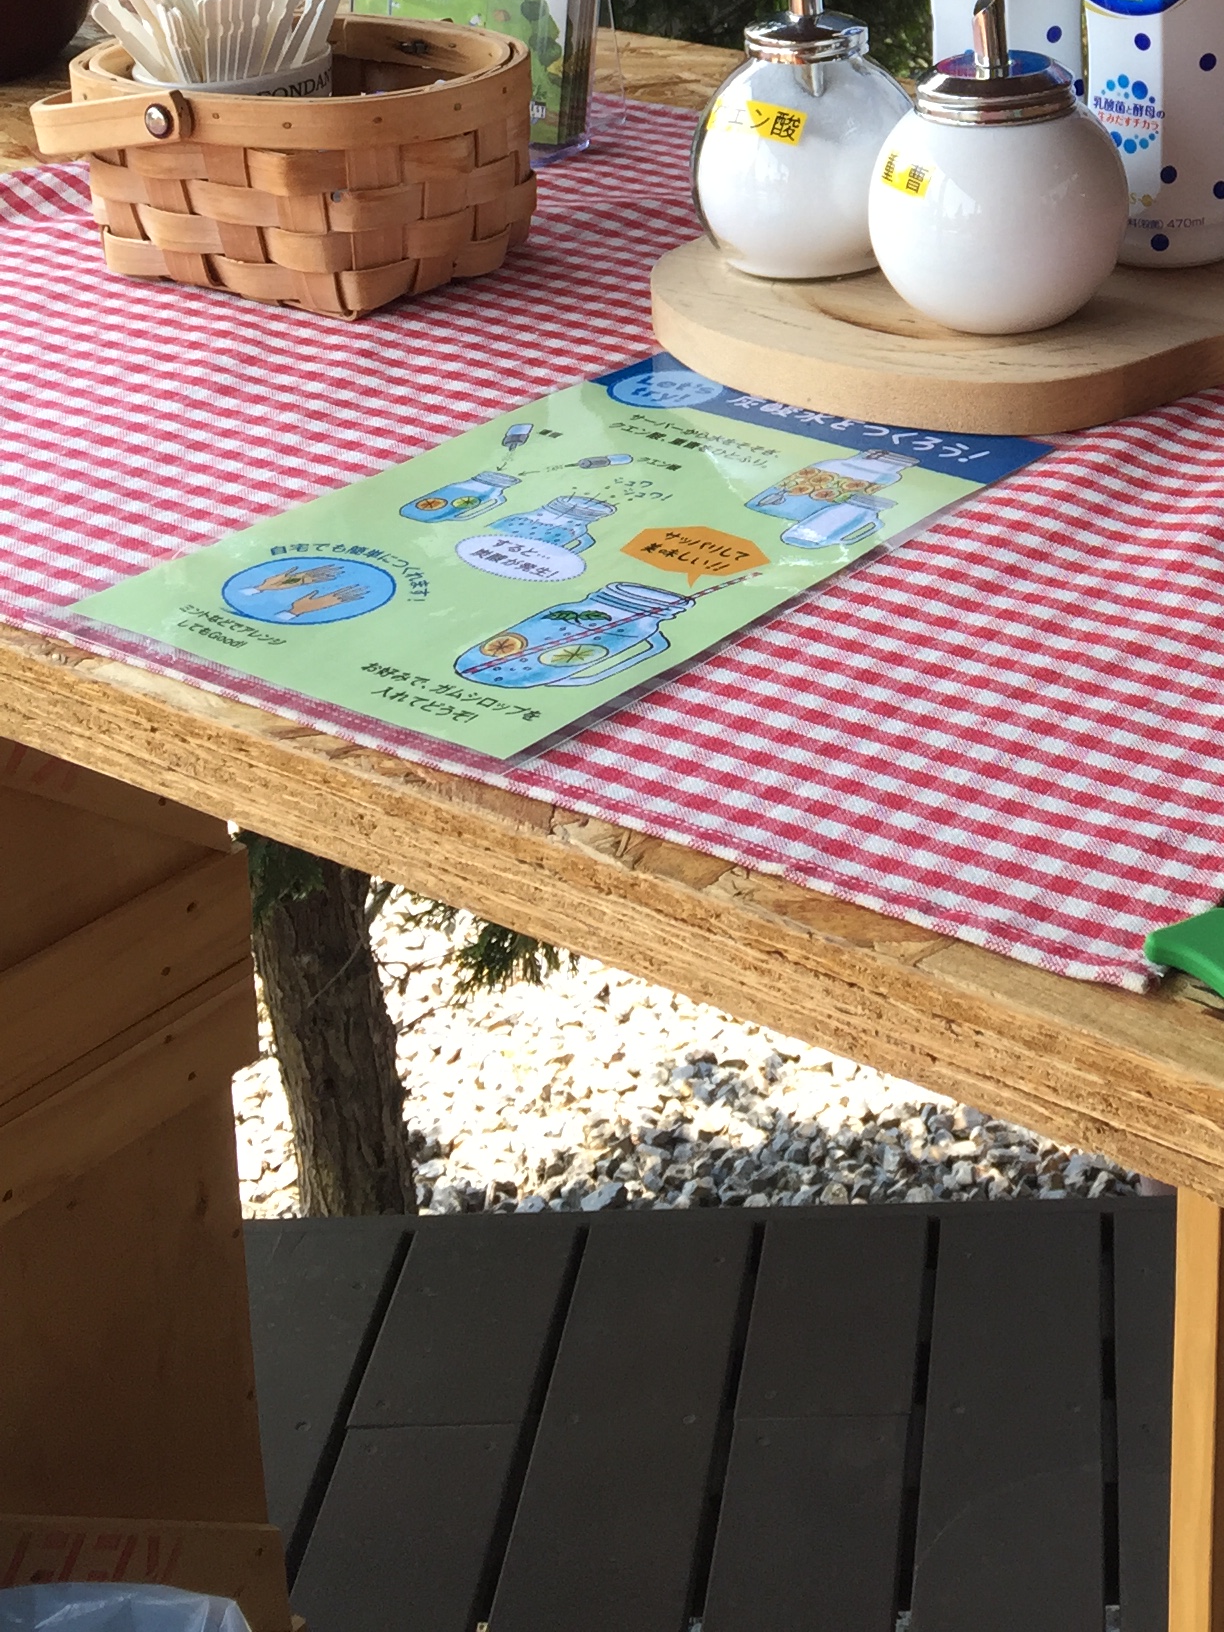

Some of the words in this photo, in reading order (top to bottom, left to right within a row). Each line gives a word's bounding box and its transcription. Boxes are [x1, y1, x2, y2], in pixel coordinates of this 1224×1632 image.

[1093, 95, 1166, 119] 乳酸菌と酵母の
[664, 531, 750, 561] サッパリして
[469, 548, 560, 579] 炭酸が発生!
[179, 604, 287, 645] ミントなどでアレンジ
[360, 662, 542, 722] お好みで、ガムシロップを
[371, 686, 479, 724] 入れてどうぞ!
